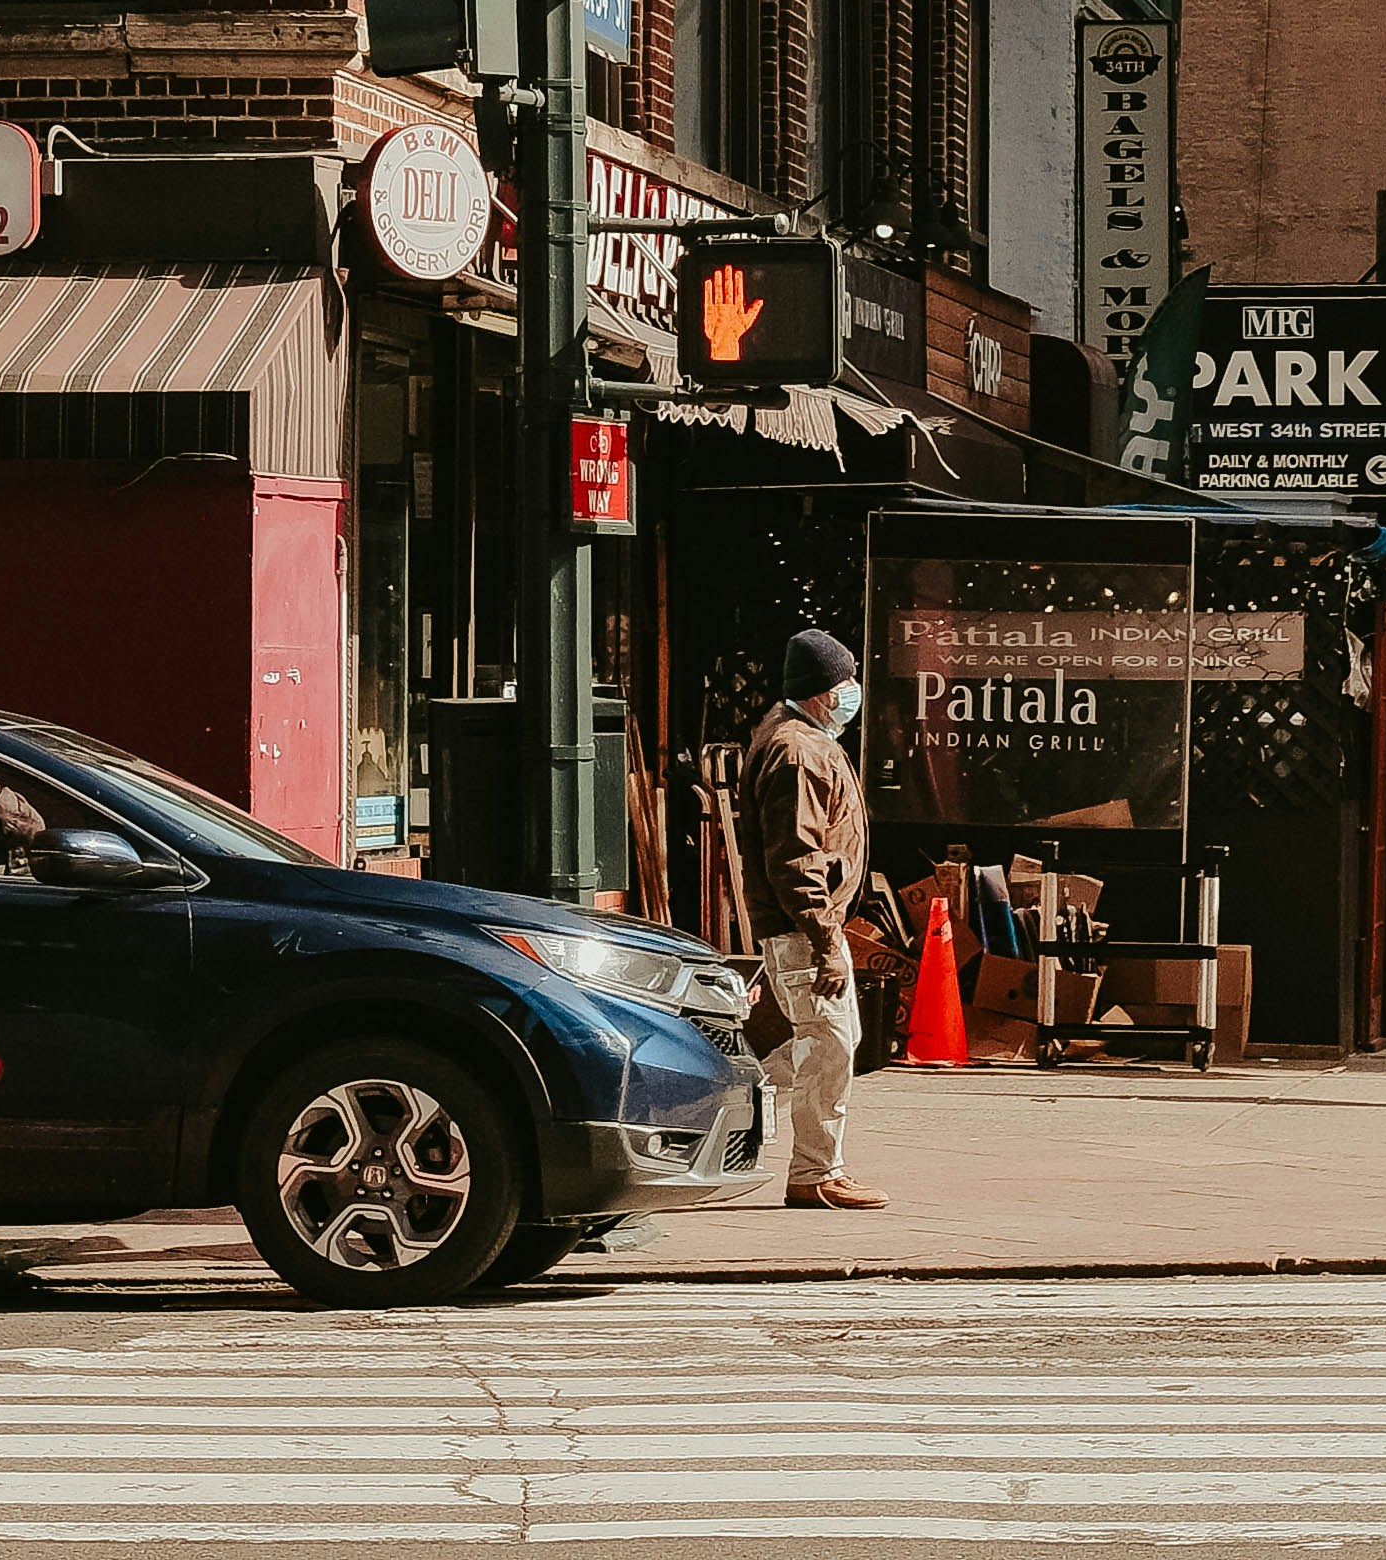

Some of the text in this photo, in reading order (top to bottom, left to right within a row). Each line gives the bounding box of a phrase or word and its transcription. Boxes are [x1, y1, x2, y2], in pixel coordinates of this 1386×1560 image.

[1105, 59, 1146, 74] 34TH
[1101, 91, 1150, 231] BAGELS
[402, 167, 459, 223] DELI
[377, 212, 451, 272] GROCERY
[1247, 309, 1311, 338] MPG
[1209, 423, 1263, 438] WEST
[1270, 423, 1312, 438] 34th
[579, 458, 619, 485] WRONG
[1209, 454, 1348, 469] DAILY & MONTHLY
[1199, 473, 1359, 488] PARKING AVAILABLE
[587, 489, 611, 514] WAY
[899, 619, 1292, 648] Patiala INDIAN GRILL
[939, 654, 1254, 669] WE ARE OPEN FOR DNING
[915, 668, 1099, 726] Patiala
[914, 732, 1103, 752] INDIAN GRILL
